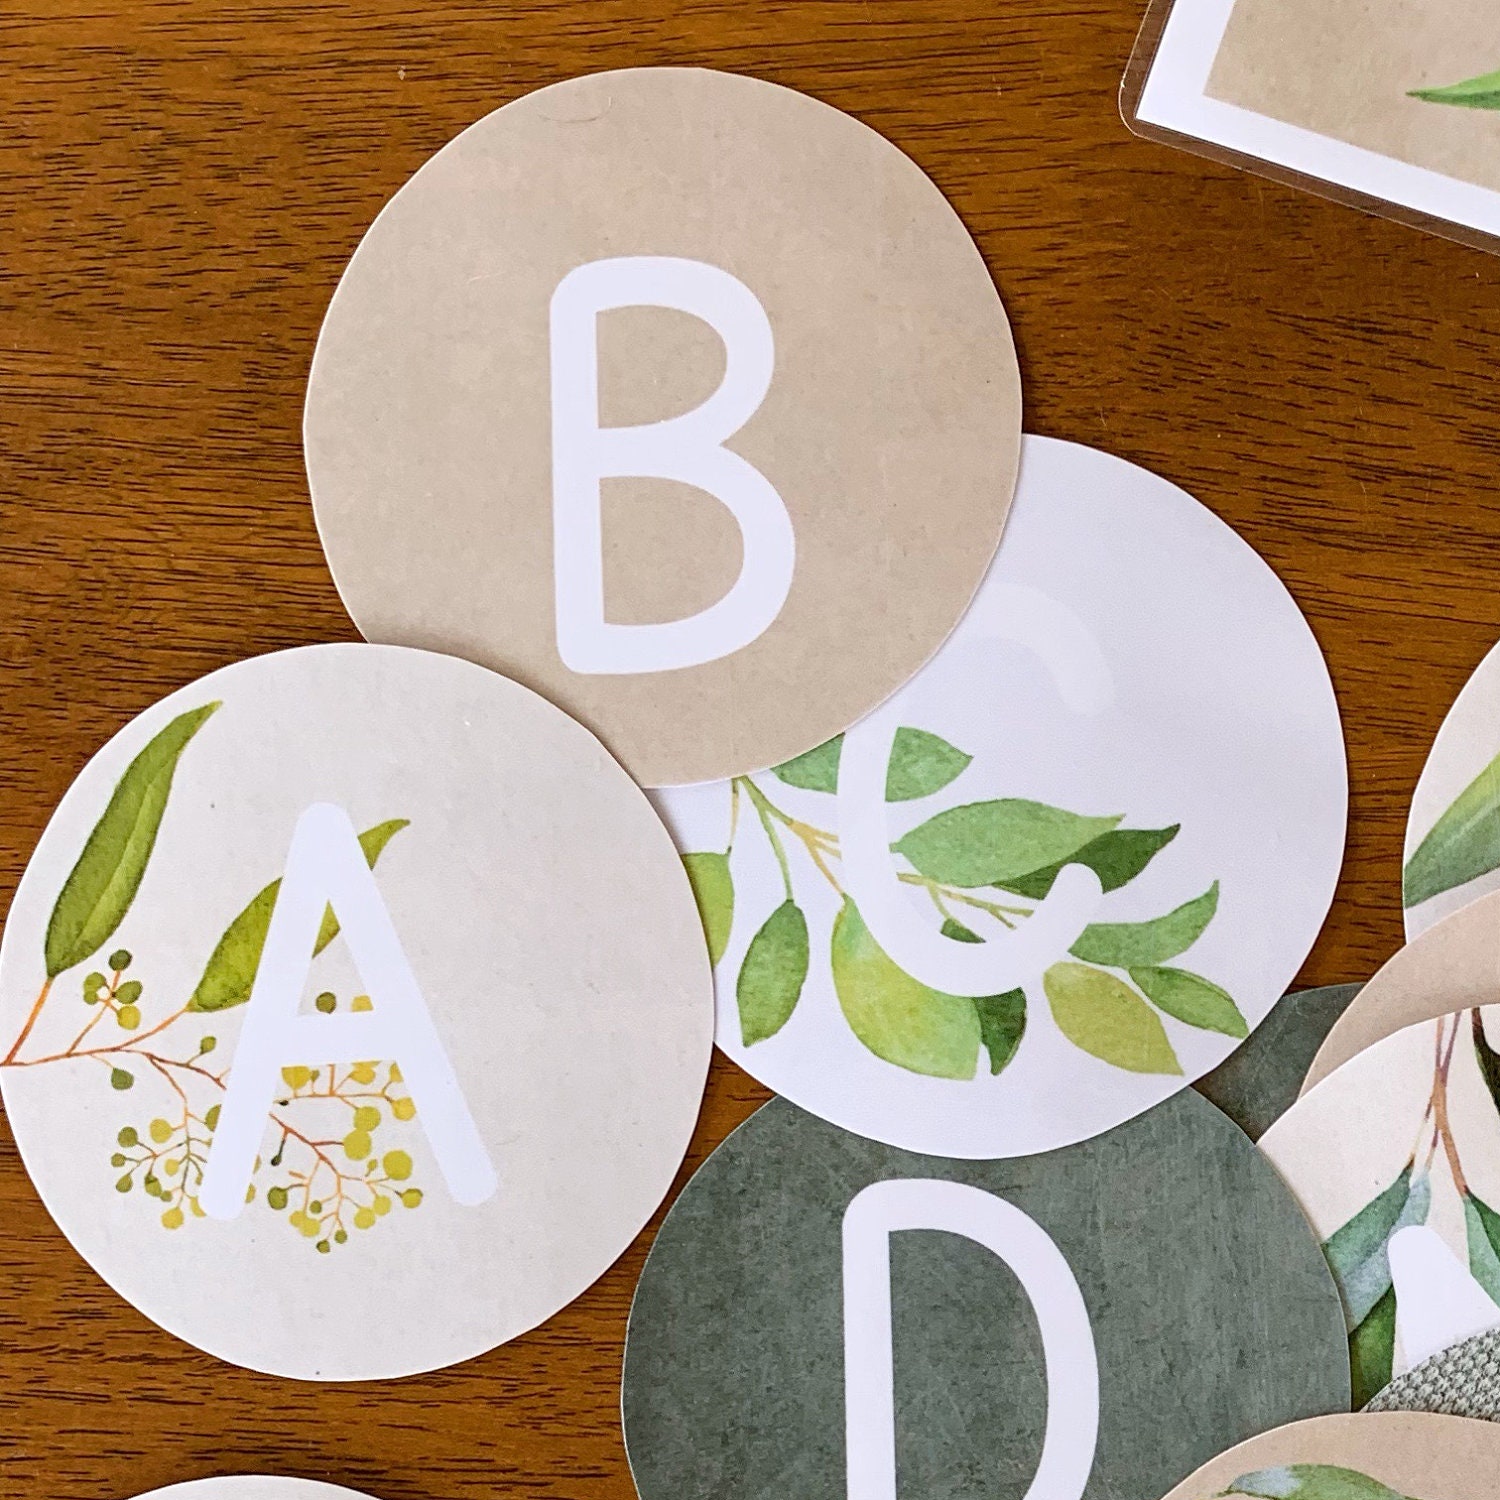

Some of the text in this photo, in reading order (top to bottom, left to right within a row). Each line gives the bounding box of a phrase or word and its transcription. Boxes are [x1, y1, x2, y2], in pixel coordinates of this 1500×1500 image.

[549, 255, 797, 676] B
[836, 582, 1116, 998] C
[199, 802, 500, 1221] A
